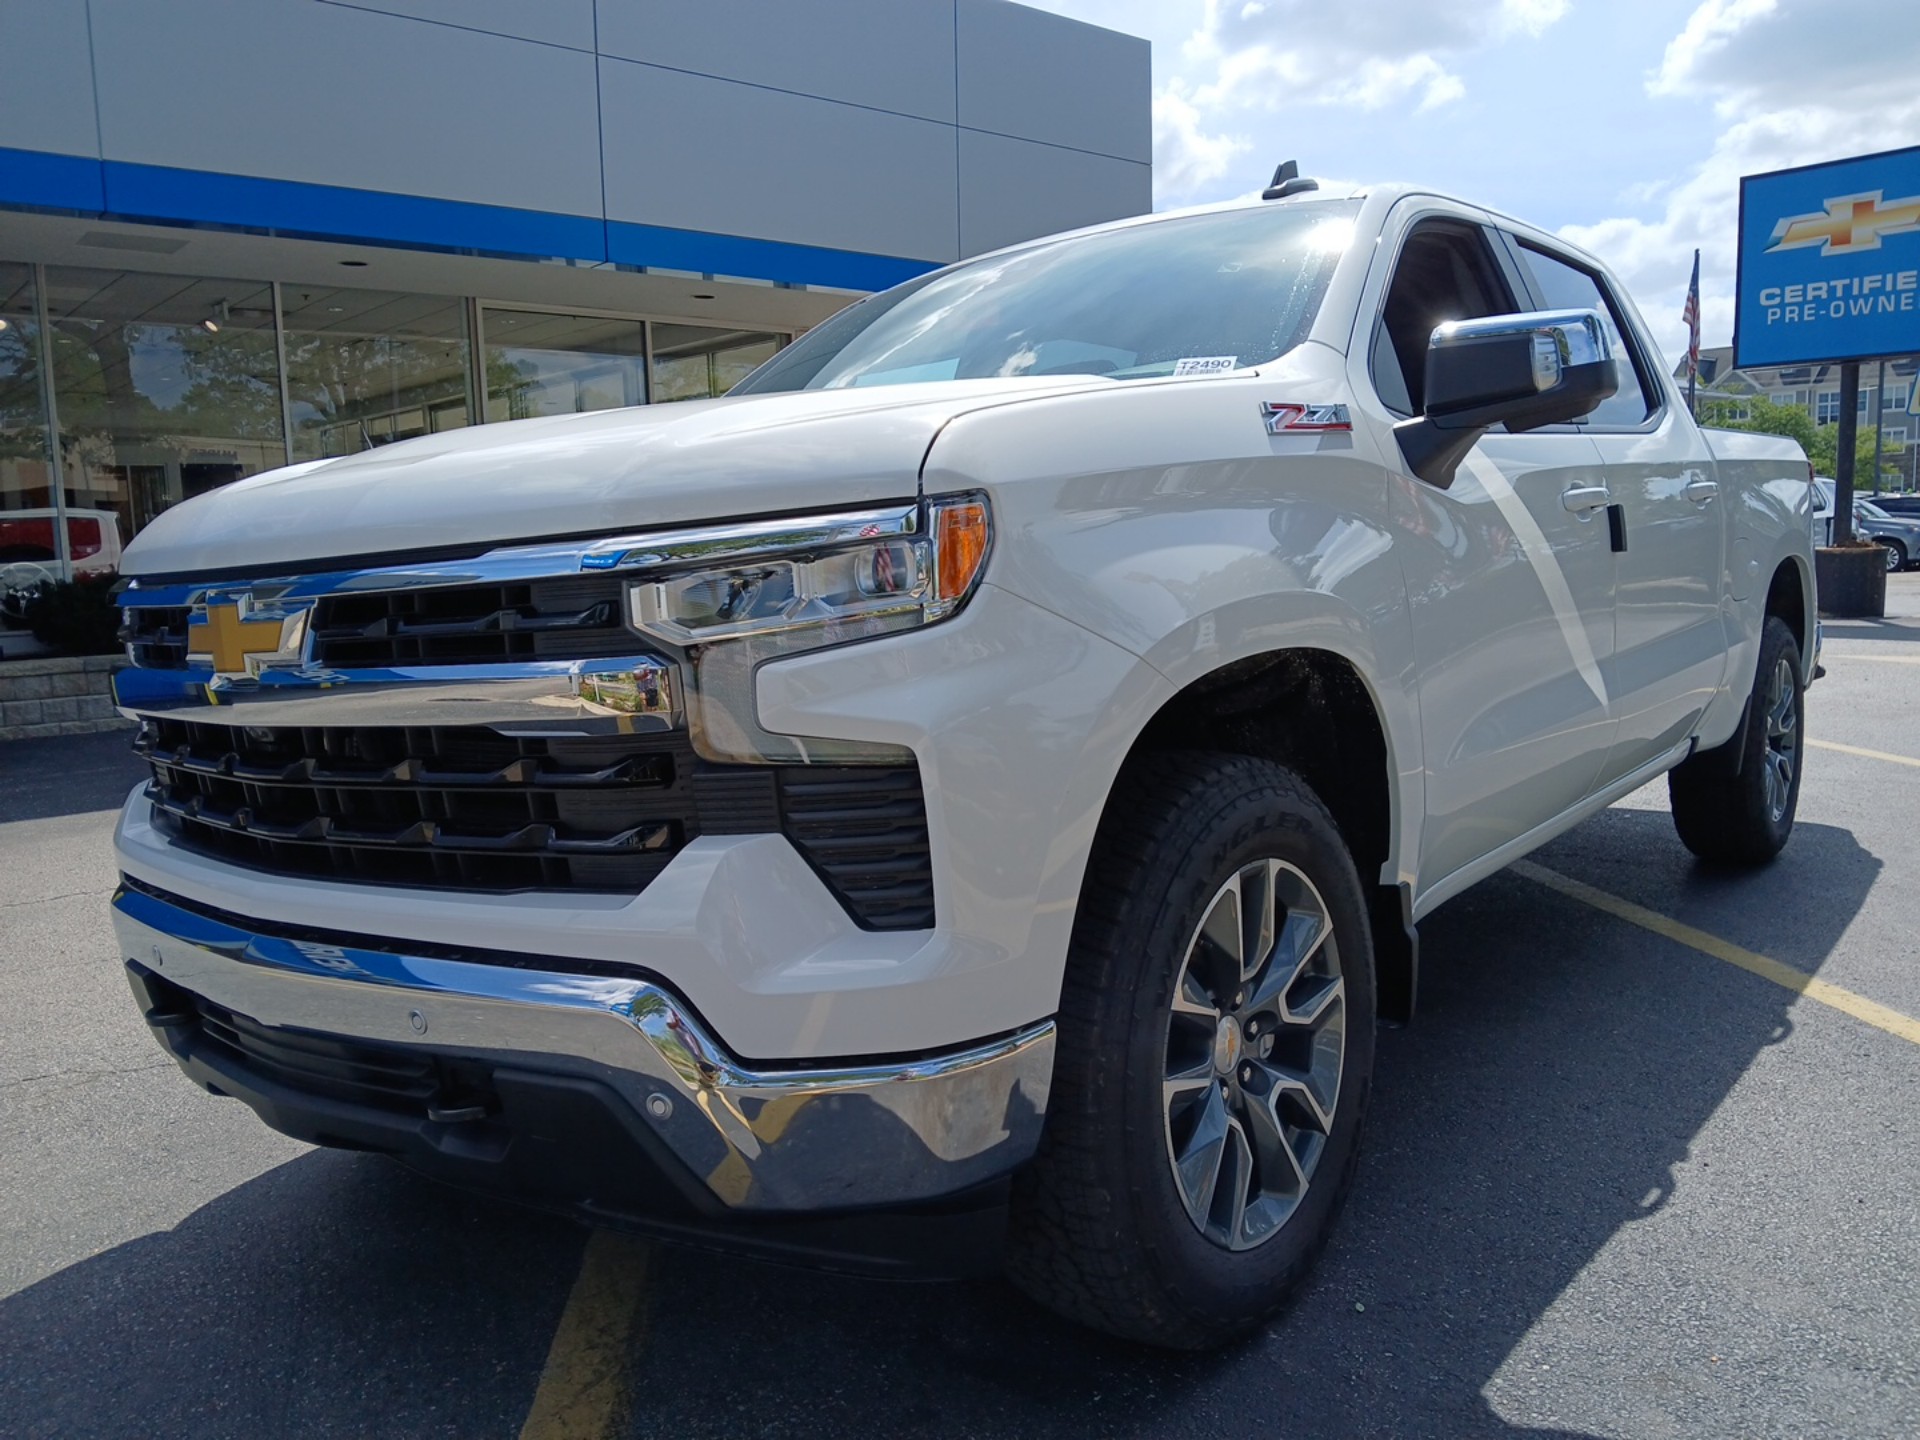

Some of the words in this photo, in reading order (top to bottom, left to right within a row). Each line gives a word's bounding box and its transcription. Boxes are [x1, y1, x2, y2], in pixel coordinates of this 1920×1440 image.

[1759, 270, 1918, 306] CERTIFIE
[1767, 292, 1920, 325] PRE-OWNE
[1179, 359, 1232, 370] T2490
[1259, 400, 1353, 435] Z71
